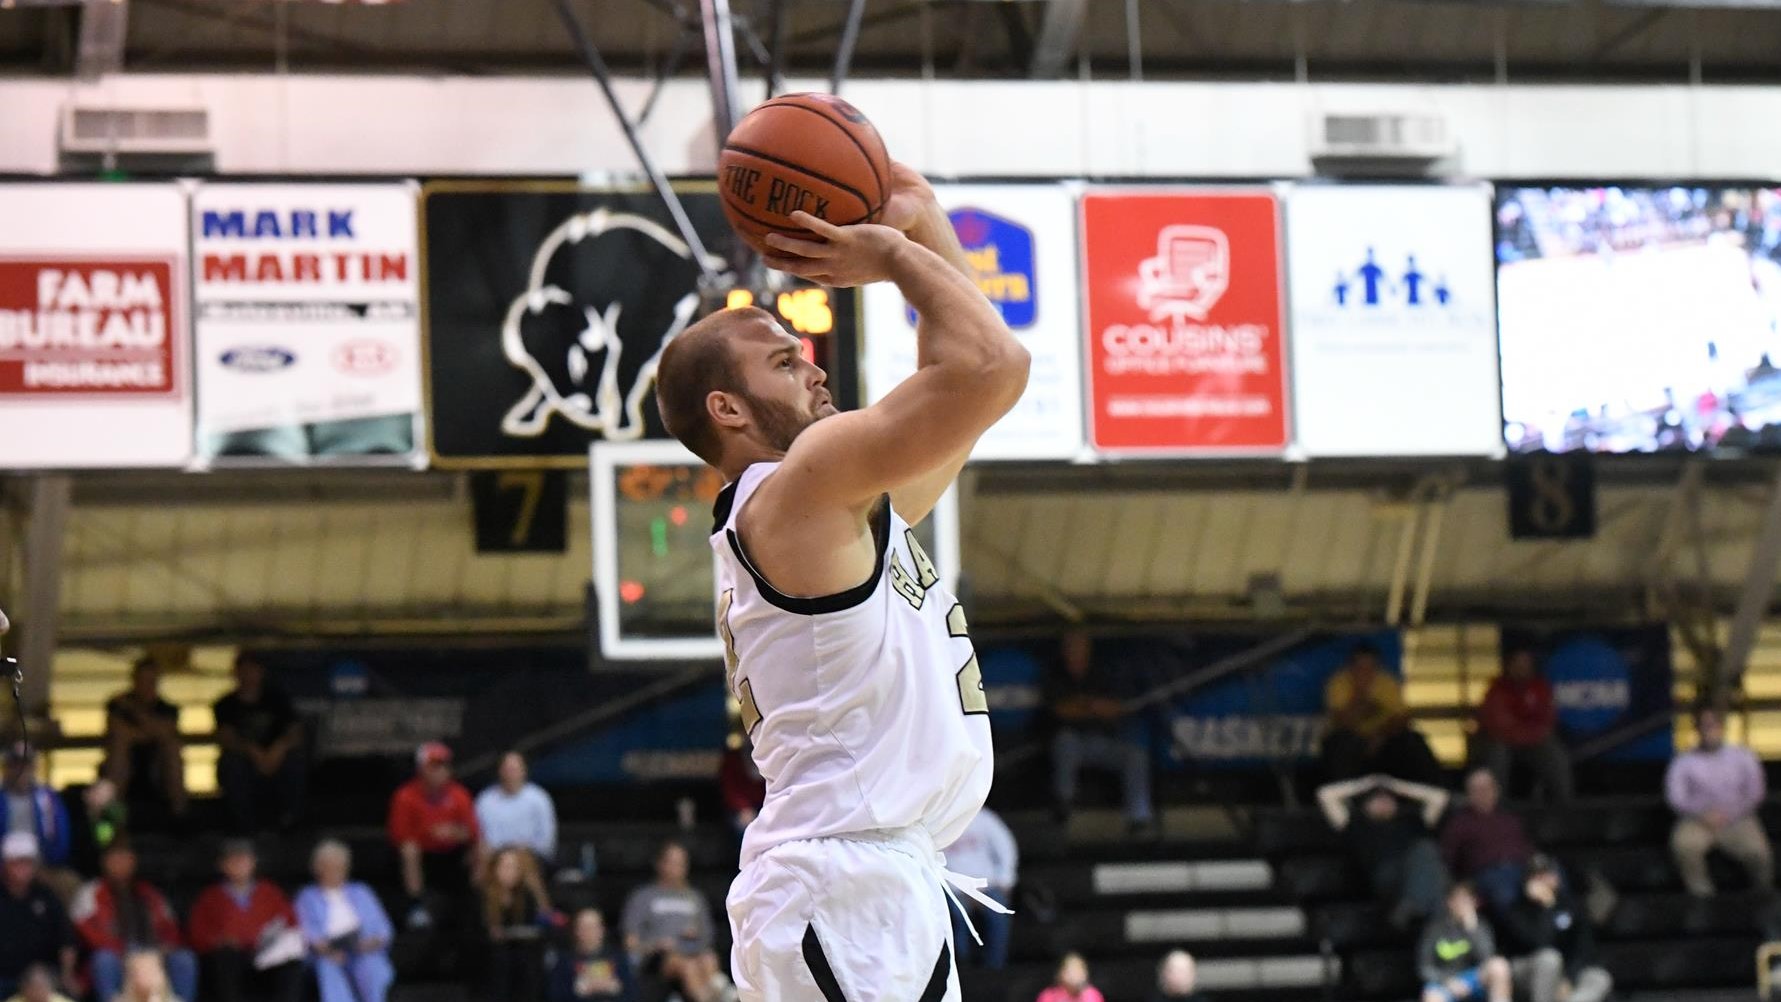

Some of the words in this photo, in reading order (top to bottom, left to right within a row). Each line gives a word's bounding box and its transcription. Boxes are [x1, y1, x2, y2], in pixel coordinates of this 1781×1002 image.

[725, 165, 761, 204] THE
[766, 177, 830, 220] ROCK
[202, 210, 355, 239] MARK
[203, 253, 408, 283] MARTIN
[37, 269, 163, 307] FARM
[0, 307, 166, 349] BUREAU
[1101, 323, 1264, 357] COUSINS
[497, 469, 545, 549] 7
